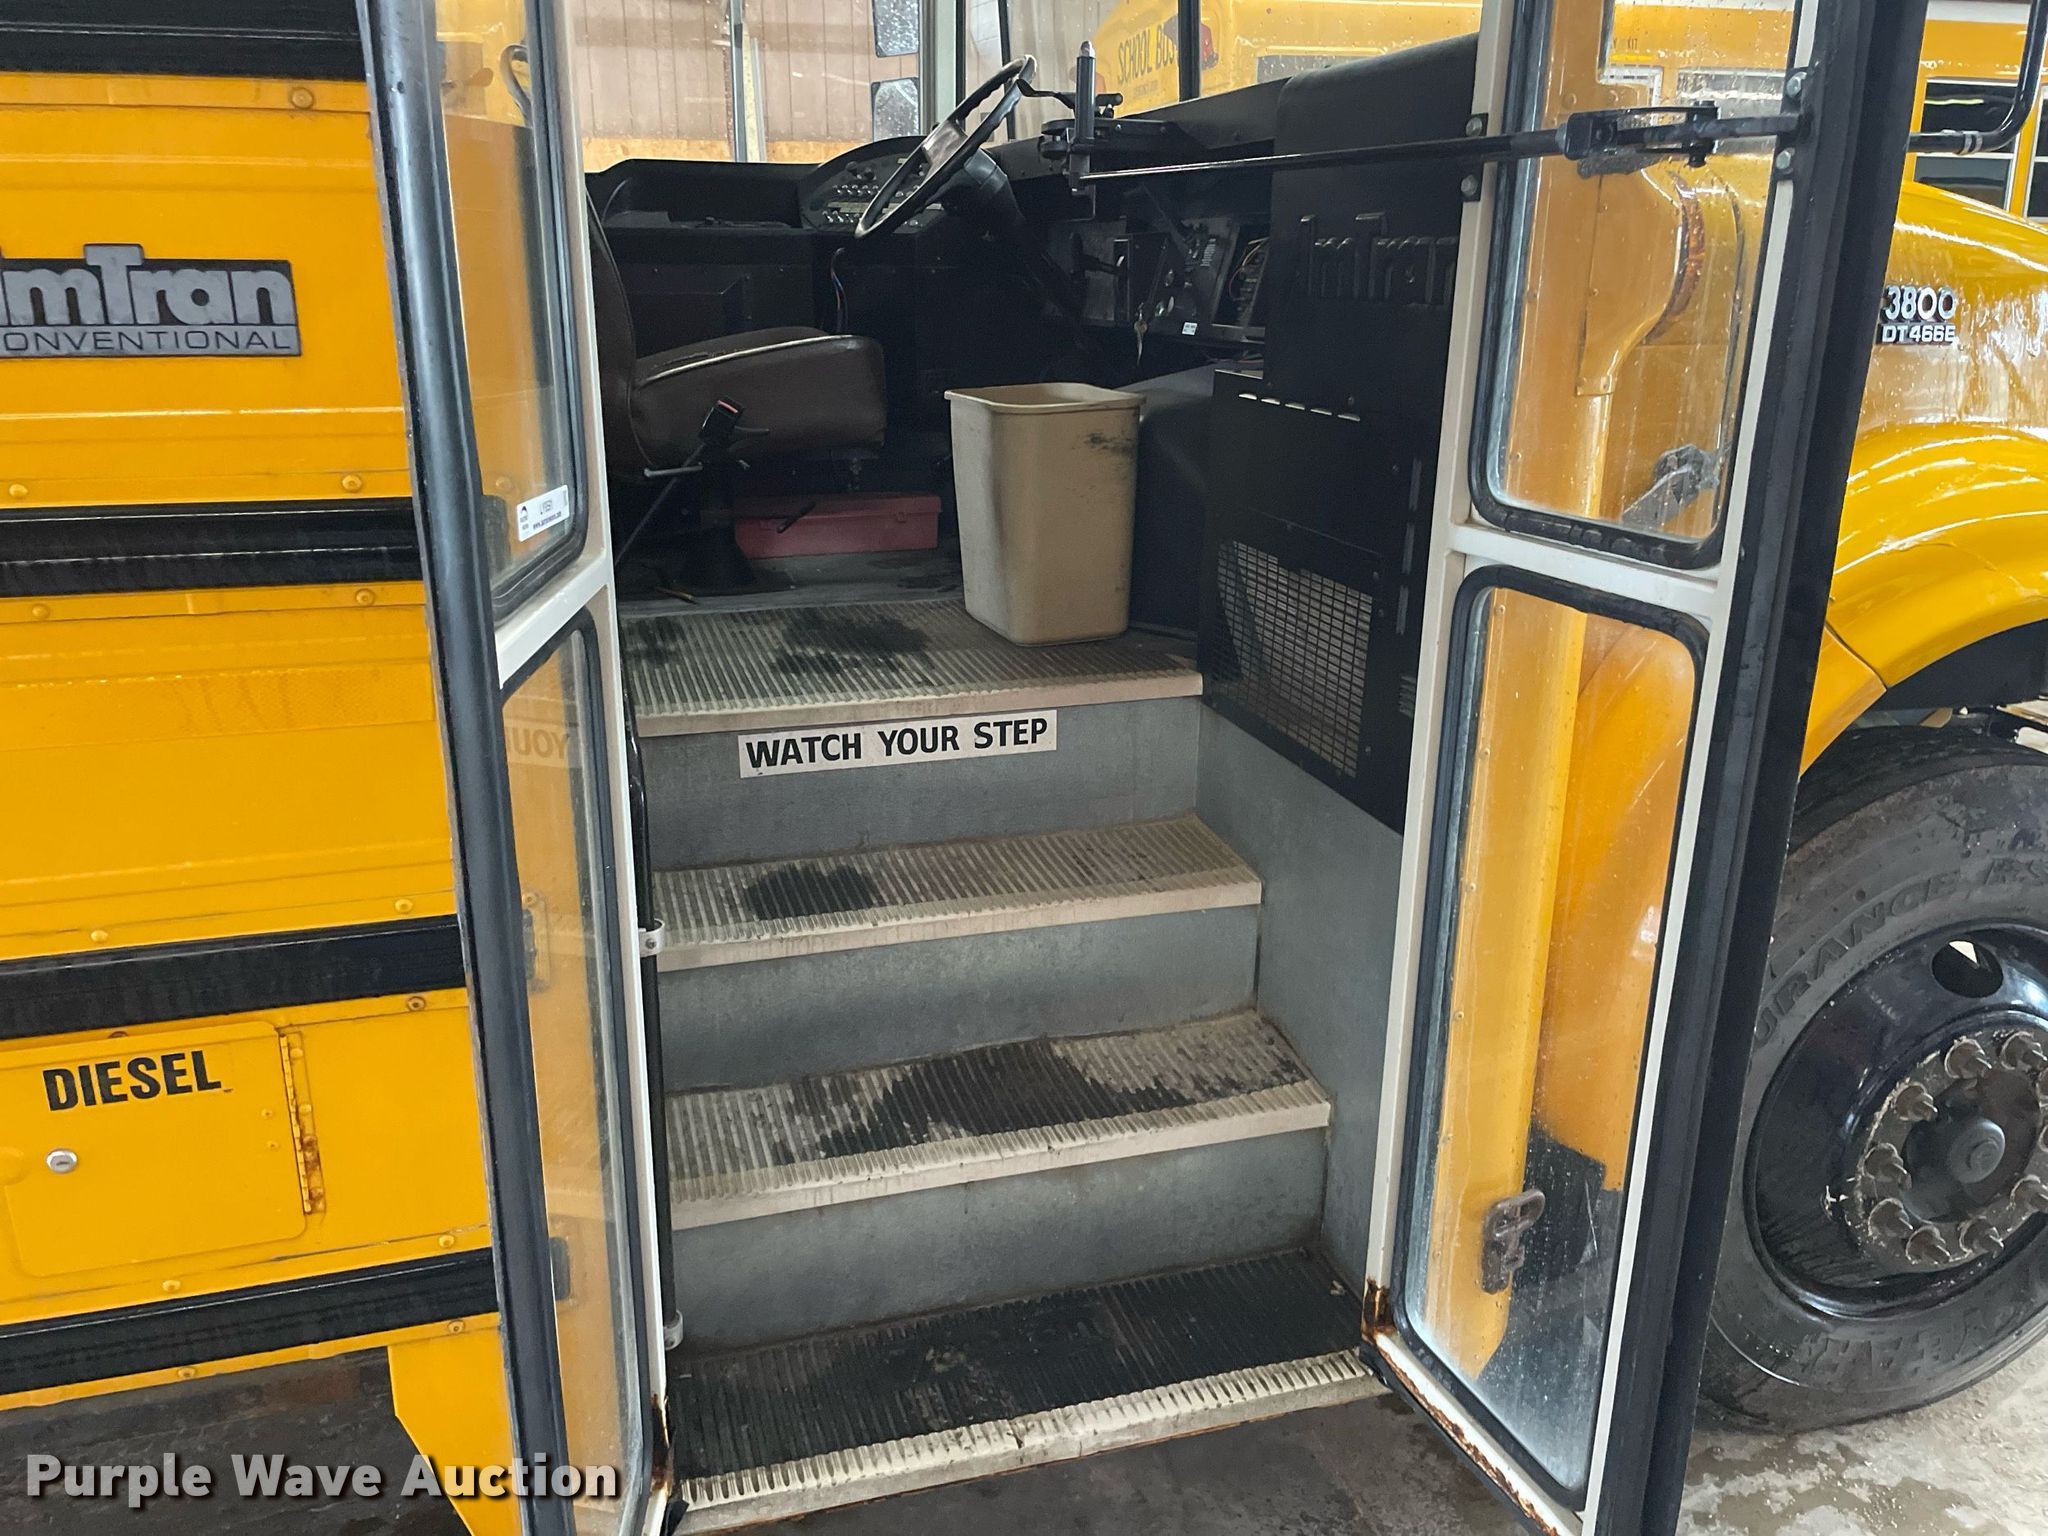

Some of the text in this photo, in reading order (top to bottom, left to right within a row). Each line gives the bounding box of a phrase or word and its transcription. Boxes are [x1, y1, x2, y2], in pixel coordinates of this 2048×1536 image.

[1118, 24, 1176, 84] SCHOOL BUS
[0, 243, 295, 325] mTran
[1884, 285, 1957, 321] 3800
[3, 330, 292, 352] ONVENTIONAL
[745, 717, 1048, 769] WATCH YOUR STEP
[42, 1050, 222, 1112] DIESEL
